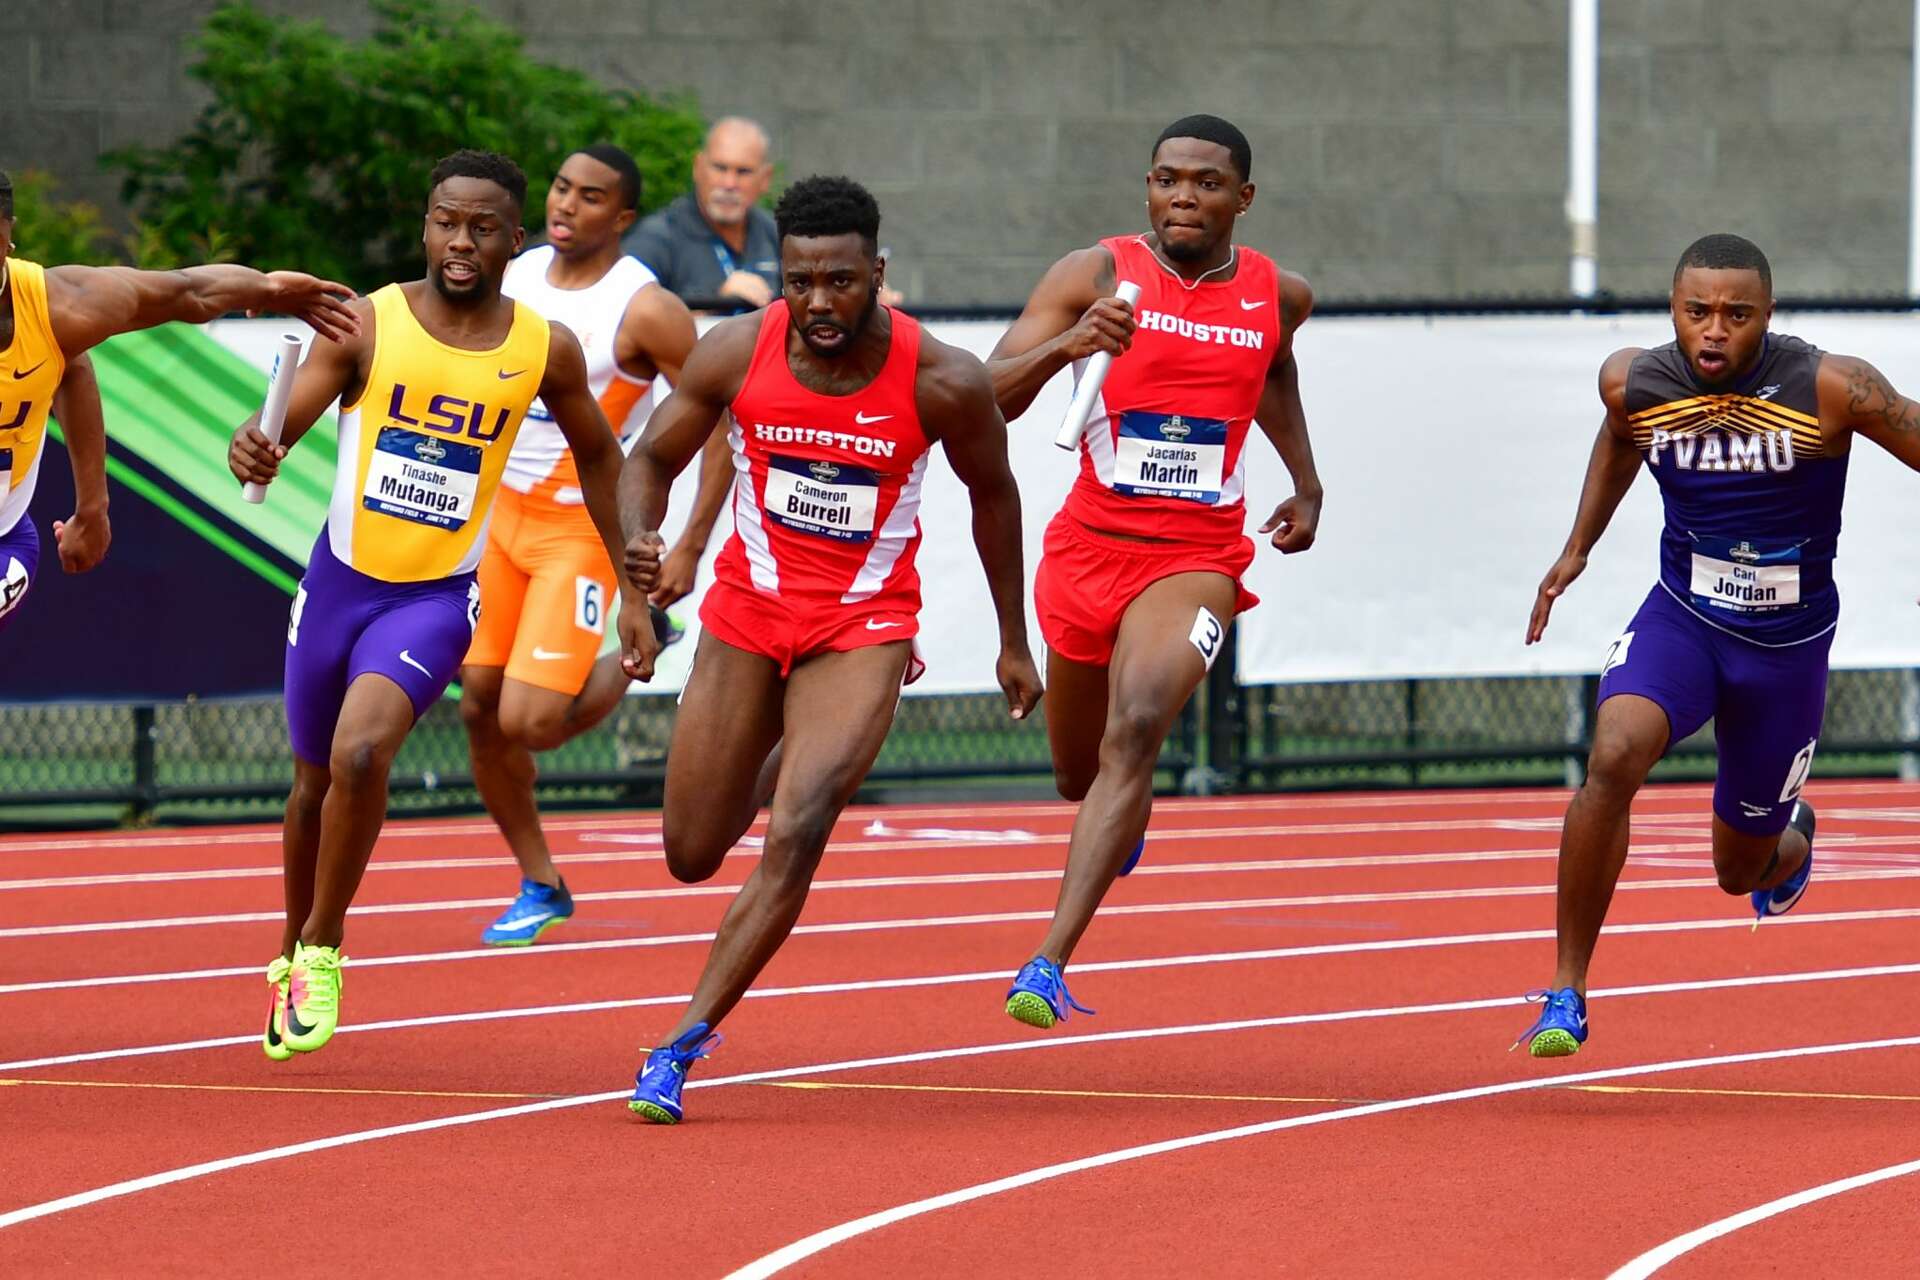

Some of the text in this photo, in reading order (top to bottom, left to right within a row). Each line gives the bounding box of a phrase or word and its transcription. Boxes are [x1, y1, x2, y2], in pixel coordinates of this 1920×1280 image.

[1138, 309, 1264, 350] HOUSTON
[388, 383, 511, 442] LSU
[754, 423, 896, 458] HOUSTON
[1147, 446, 1198, 462] Jacarias
[1649, 426, 1796, 474] PVAMU
[401, 463, 448, 486] Tinashe
[1140, 461, 1198, 485] Martin
[379, 475, 460, 512] Mutanga
[795, 480, 848, 503] Cameron
[786, 494, 851, 525] Burrell
[1713, 577, 1777, 601] Jordan
[1733, 566, 1756, 581] Carl
[585, 584, 598, 626] 6
[1198, 617, 1219, 658] 3
[1787, 749, 1810, 798] 2
